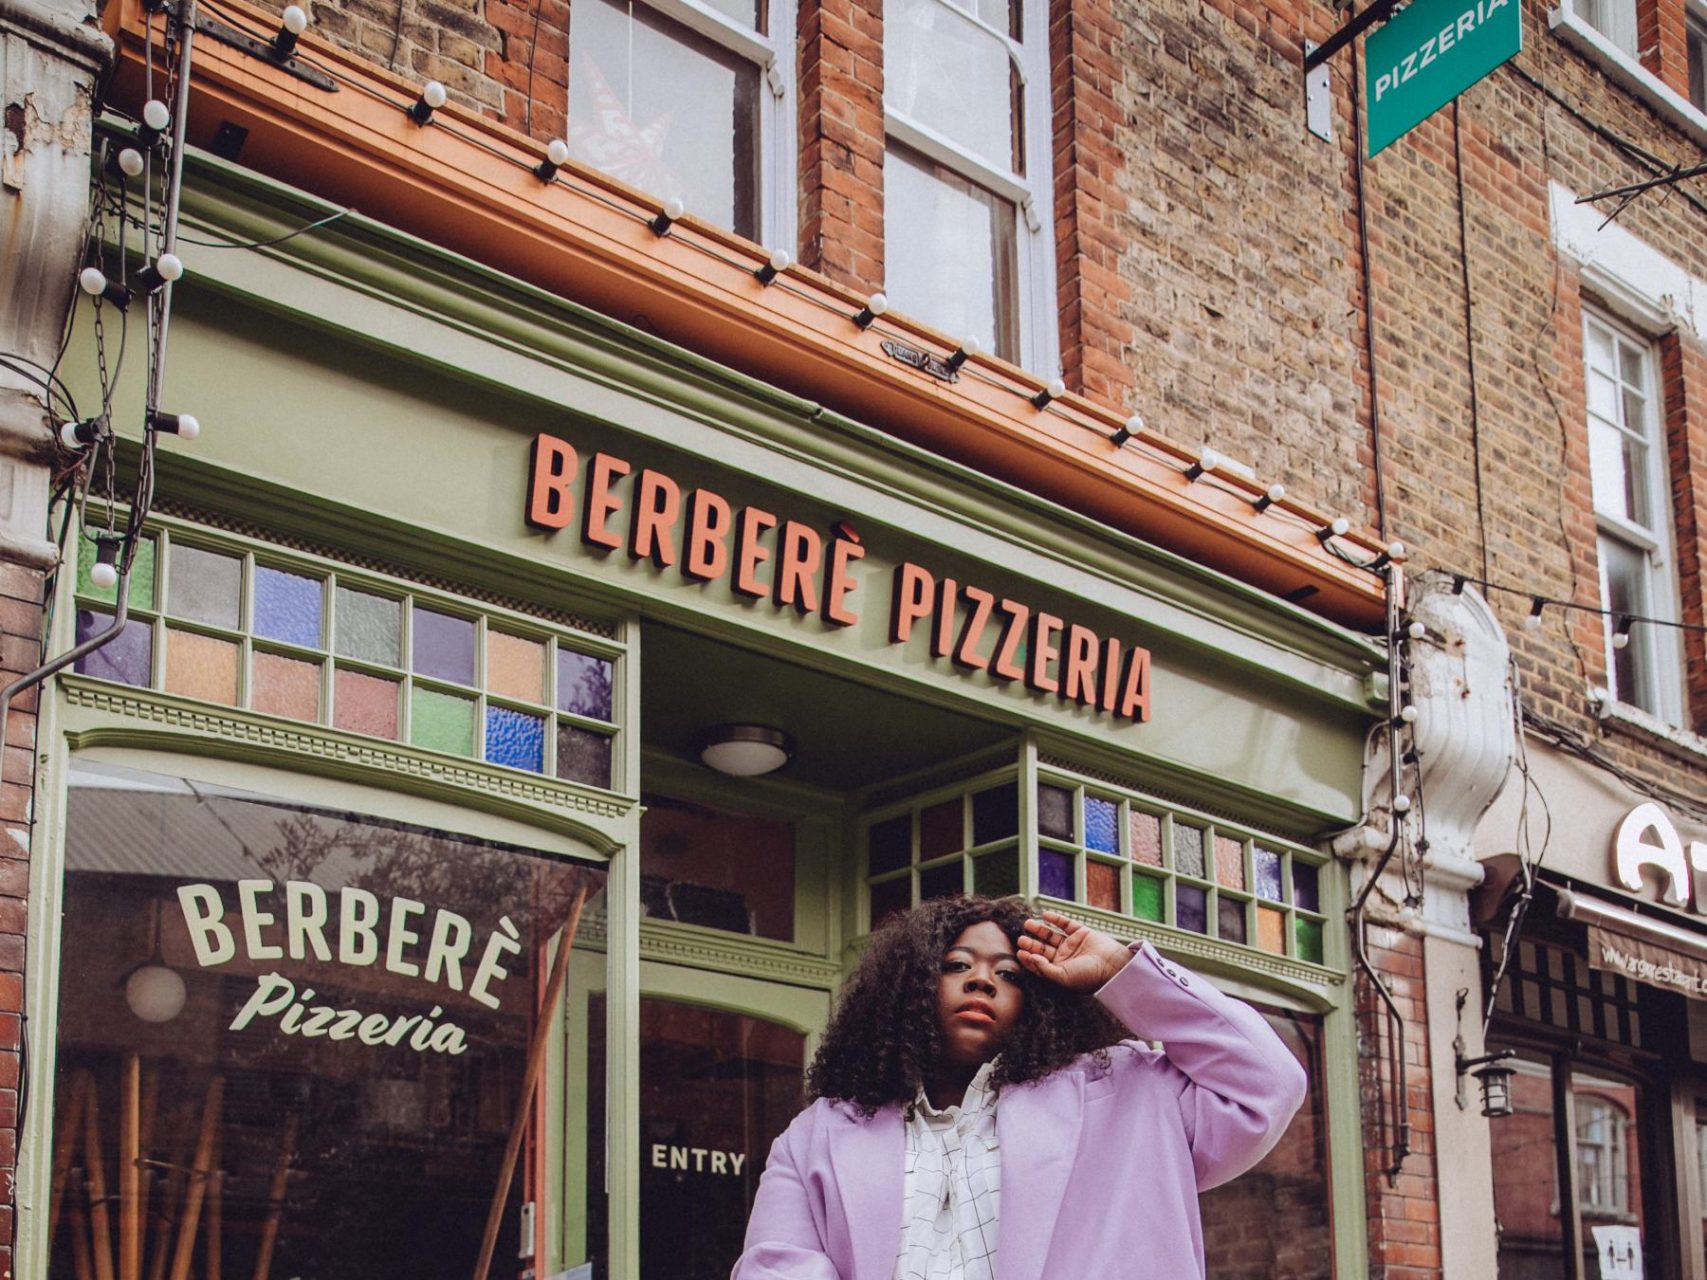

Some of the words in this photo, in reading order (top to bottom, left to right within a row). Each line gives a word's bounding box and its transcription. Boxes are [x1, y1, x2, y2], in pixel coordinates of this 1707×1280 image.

[526, 432, 865, 627] BERBERÈ
[890, 561, 1151, 723] PIZZERIA
[177, 879, 522, 1010] BERBERÈ
[229, 971, 468, 1055] Pizzeria
[652, 1143, 746, 1176] ENTRY
